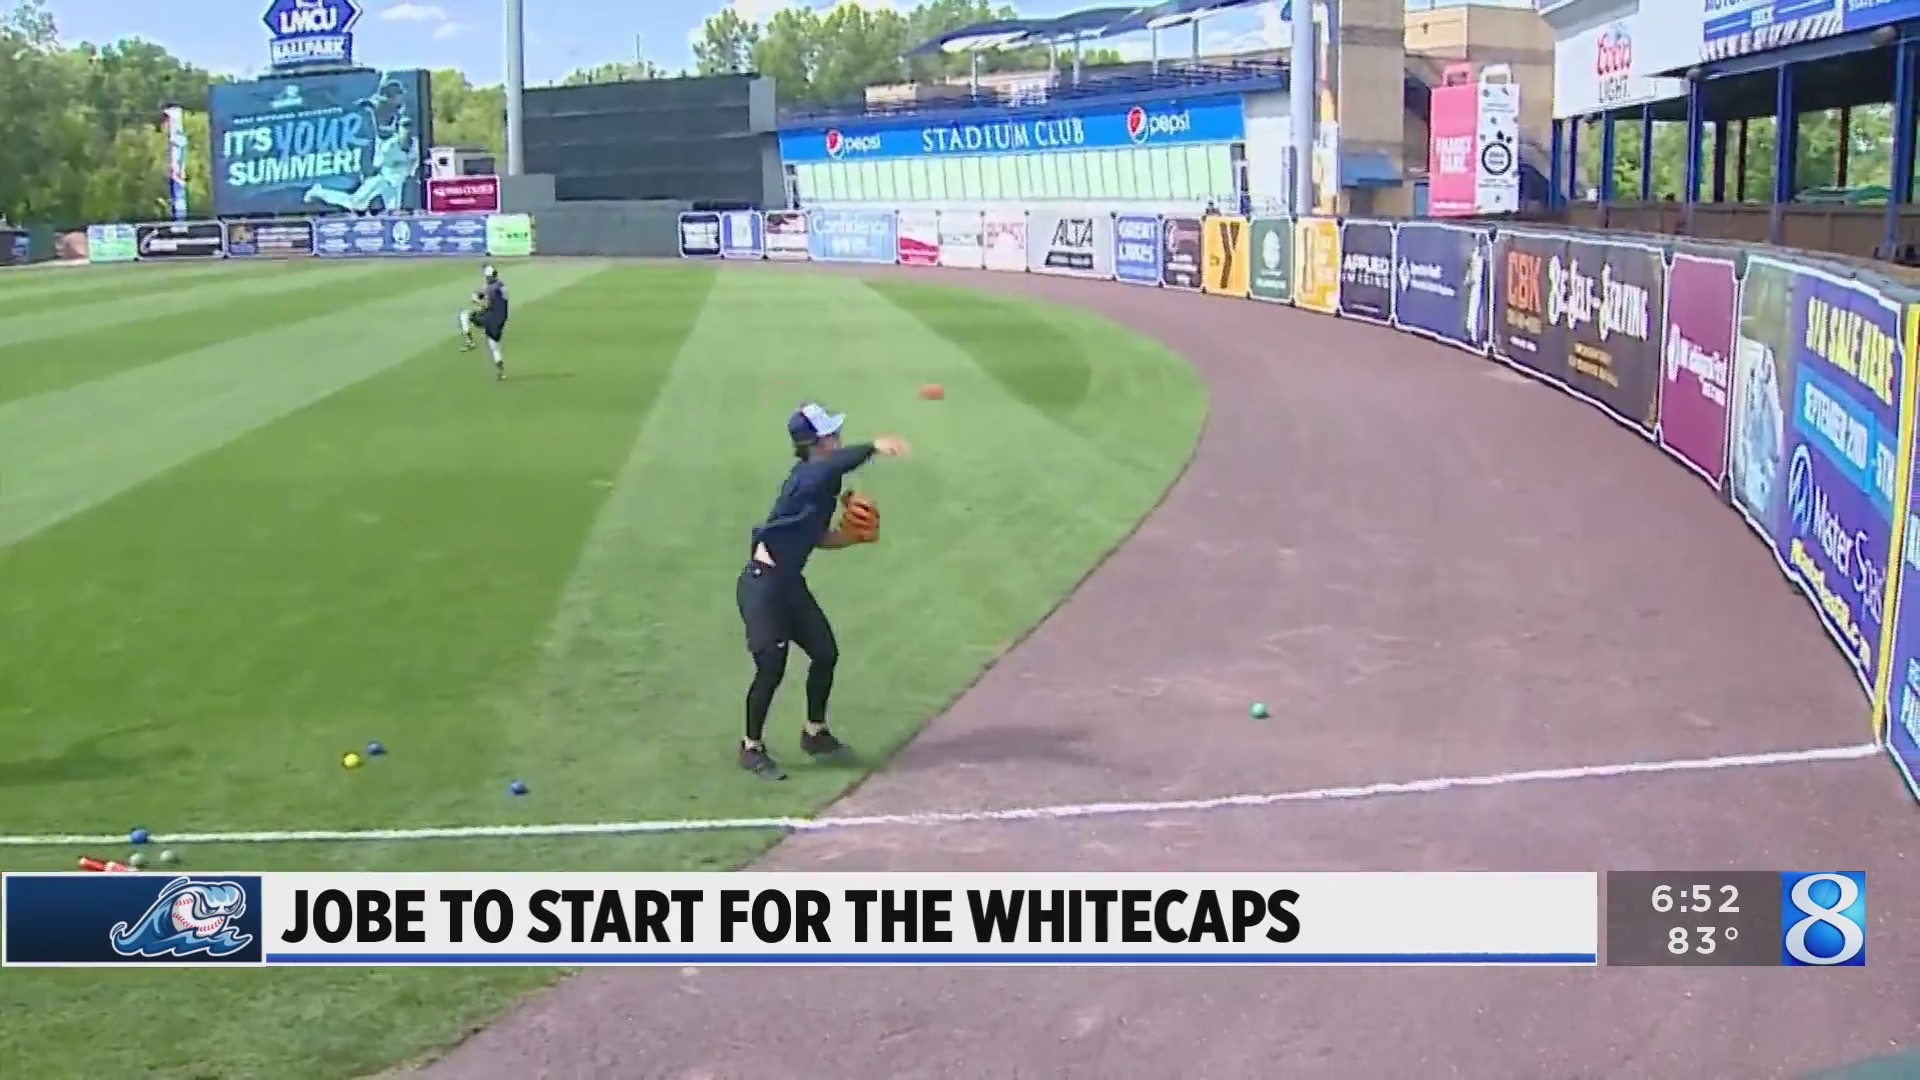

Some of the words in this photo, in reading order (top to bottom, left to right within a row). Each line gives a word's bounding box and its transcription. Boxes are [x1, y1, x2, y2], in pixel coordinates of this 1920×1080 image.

[279, 6, 337, 33] LMCU
[223, 127, 272, 158] IT'S
[274, 112, 371, 161] YOUR
[921, 122, 1029, 153] STADIUM
[1034, 117, 1085, 148] CLUB
[1148, 109, 1191, 137] pepsi
[843, 132, 882, 154] pepsi
[227, 148, 362, 186] SUMMER!
[1051, 217, 1094, 247] ALTA
[1507, 251, 1542, 313] CBK
[1828, 306, 1861, 377] SALE
